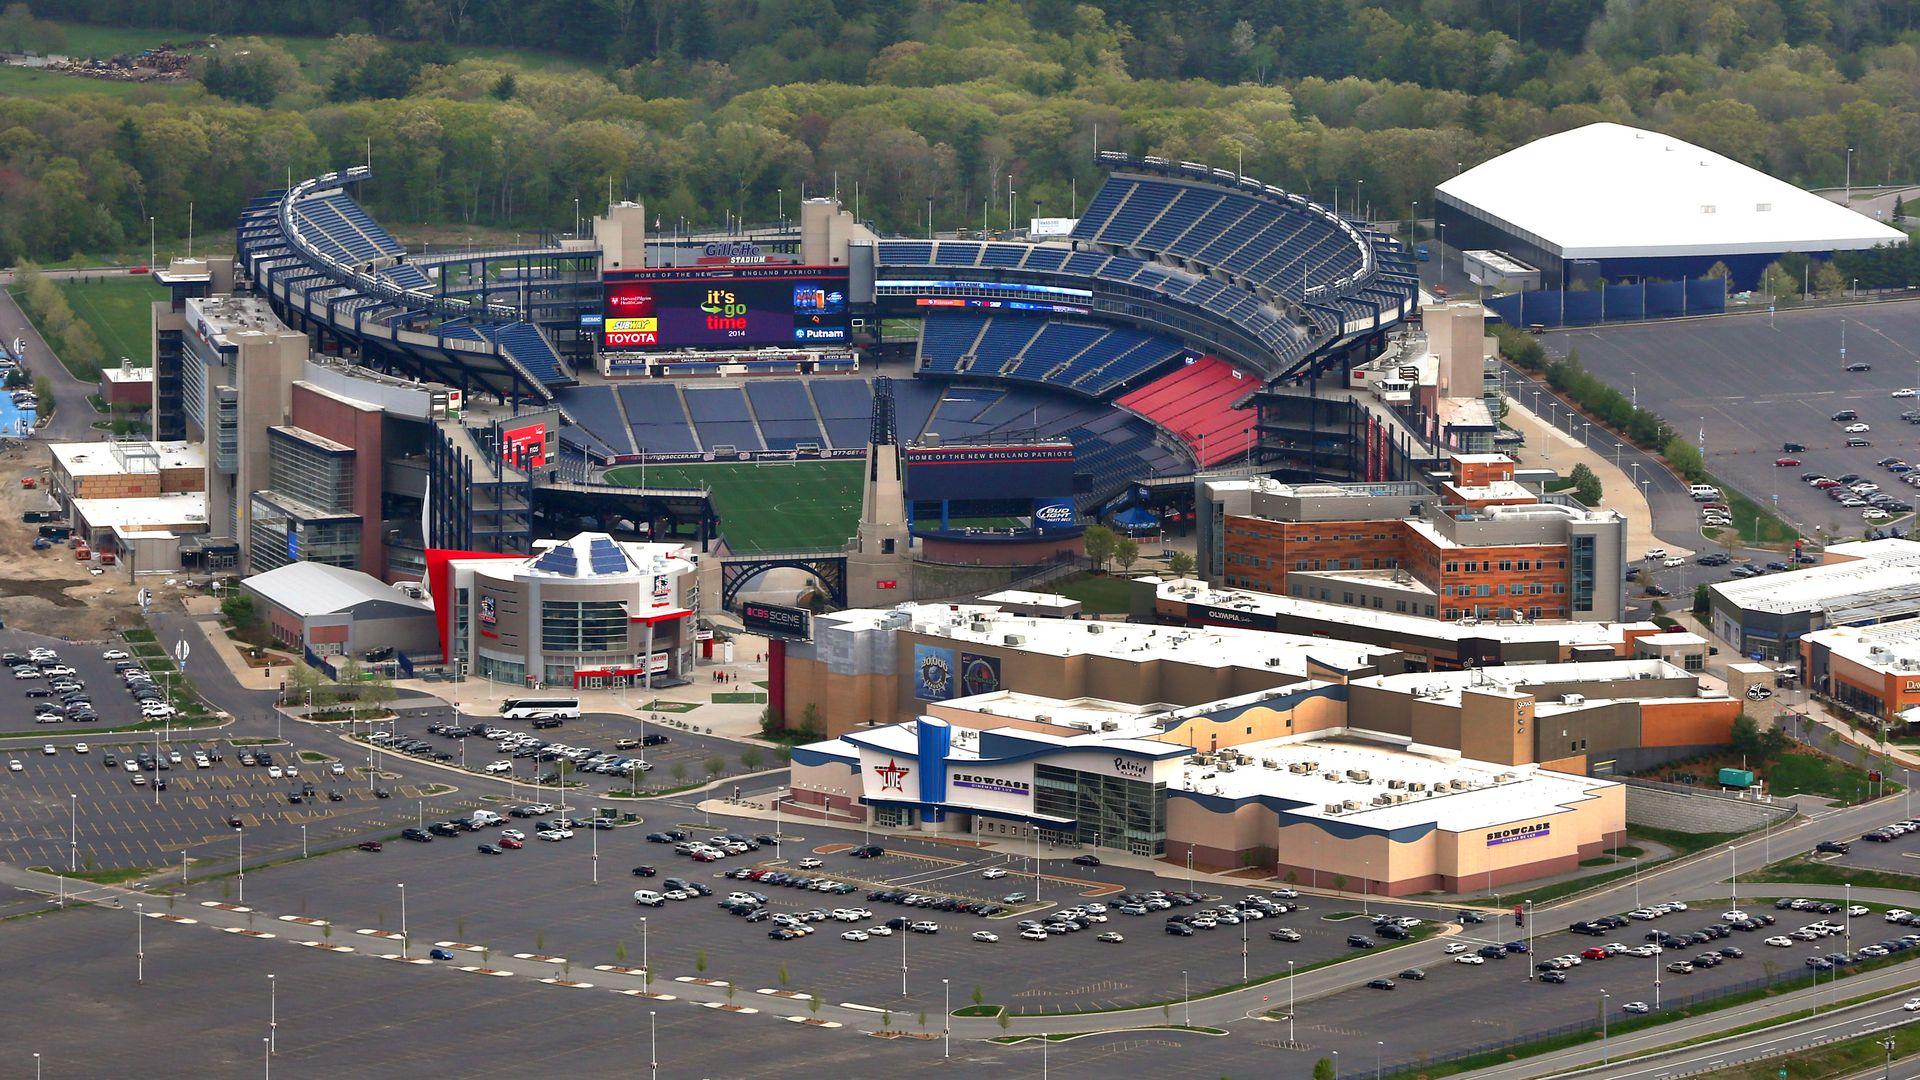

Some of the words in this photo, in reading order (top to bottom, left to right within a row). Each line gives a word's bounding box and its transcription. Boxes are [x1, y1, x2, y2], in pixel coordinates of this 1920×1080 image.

[705, 243, 760, 257] Gillette
[730, 256, 766, 264] STADIUM
[707, 289, 735, 304] it's
[725, 303, 747, 318] go
[613, 320, 650, 330] SUBWAY
[706, 315, 747, 330] time
[607, 333, 656, 343] TOYOTA
[806, 329, 844, 338] Putnam
[752, 608, 769, 618] CBS
[769, 611, 800, 624] SCENE
[1208, 611, 1240, 621] OLYMPIA
[1114, 757, 1147, 774] Patriot
[883, 771, 901, 788] LIVE
[953, 774, 1030, 790] SHOWCASE
[971, 783, 992, 791] CINEMA
[1487, 822, 1550, 840] SHOWCASE
